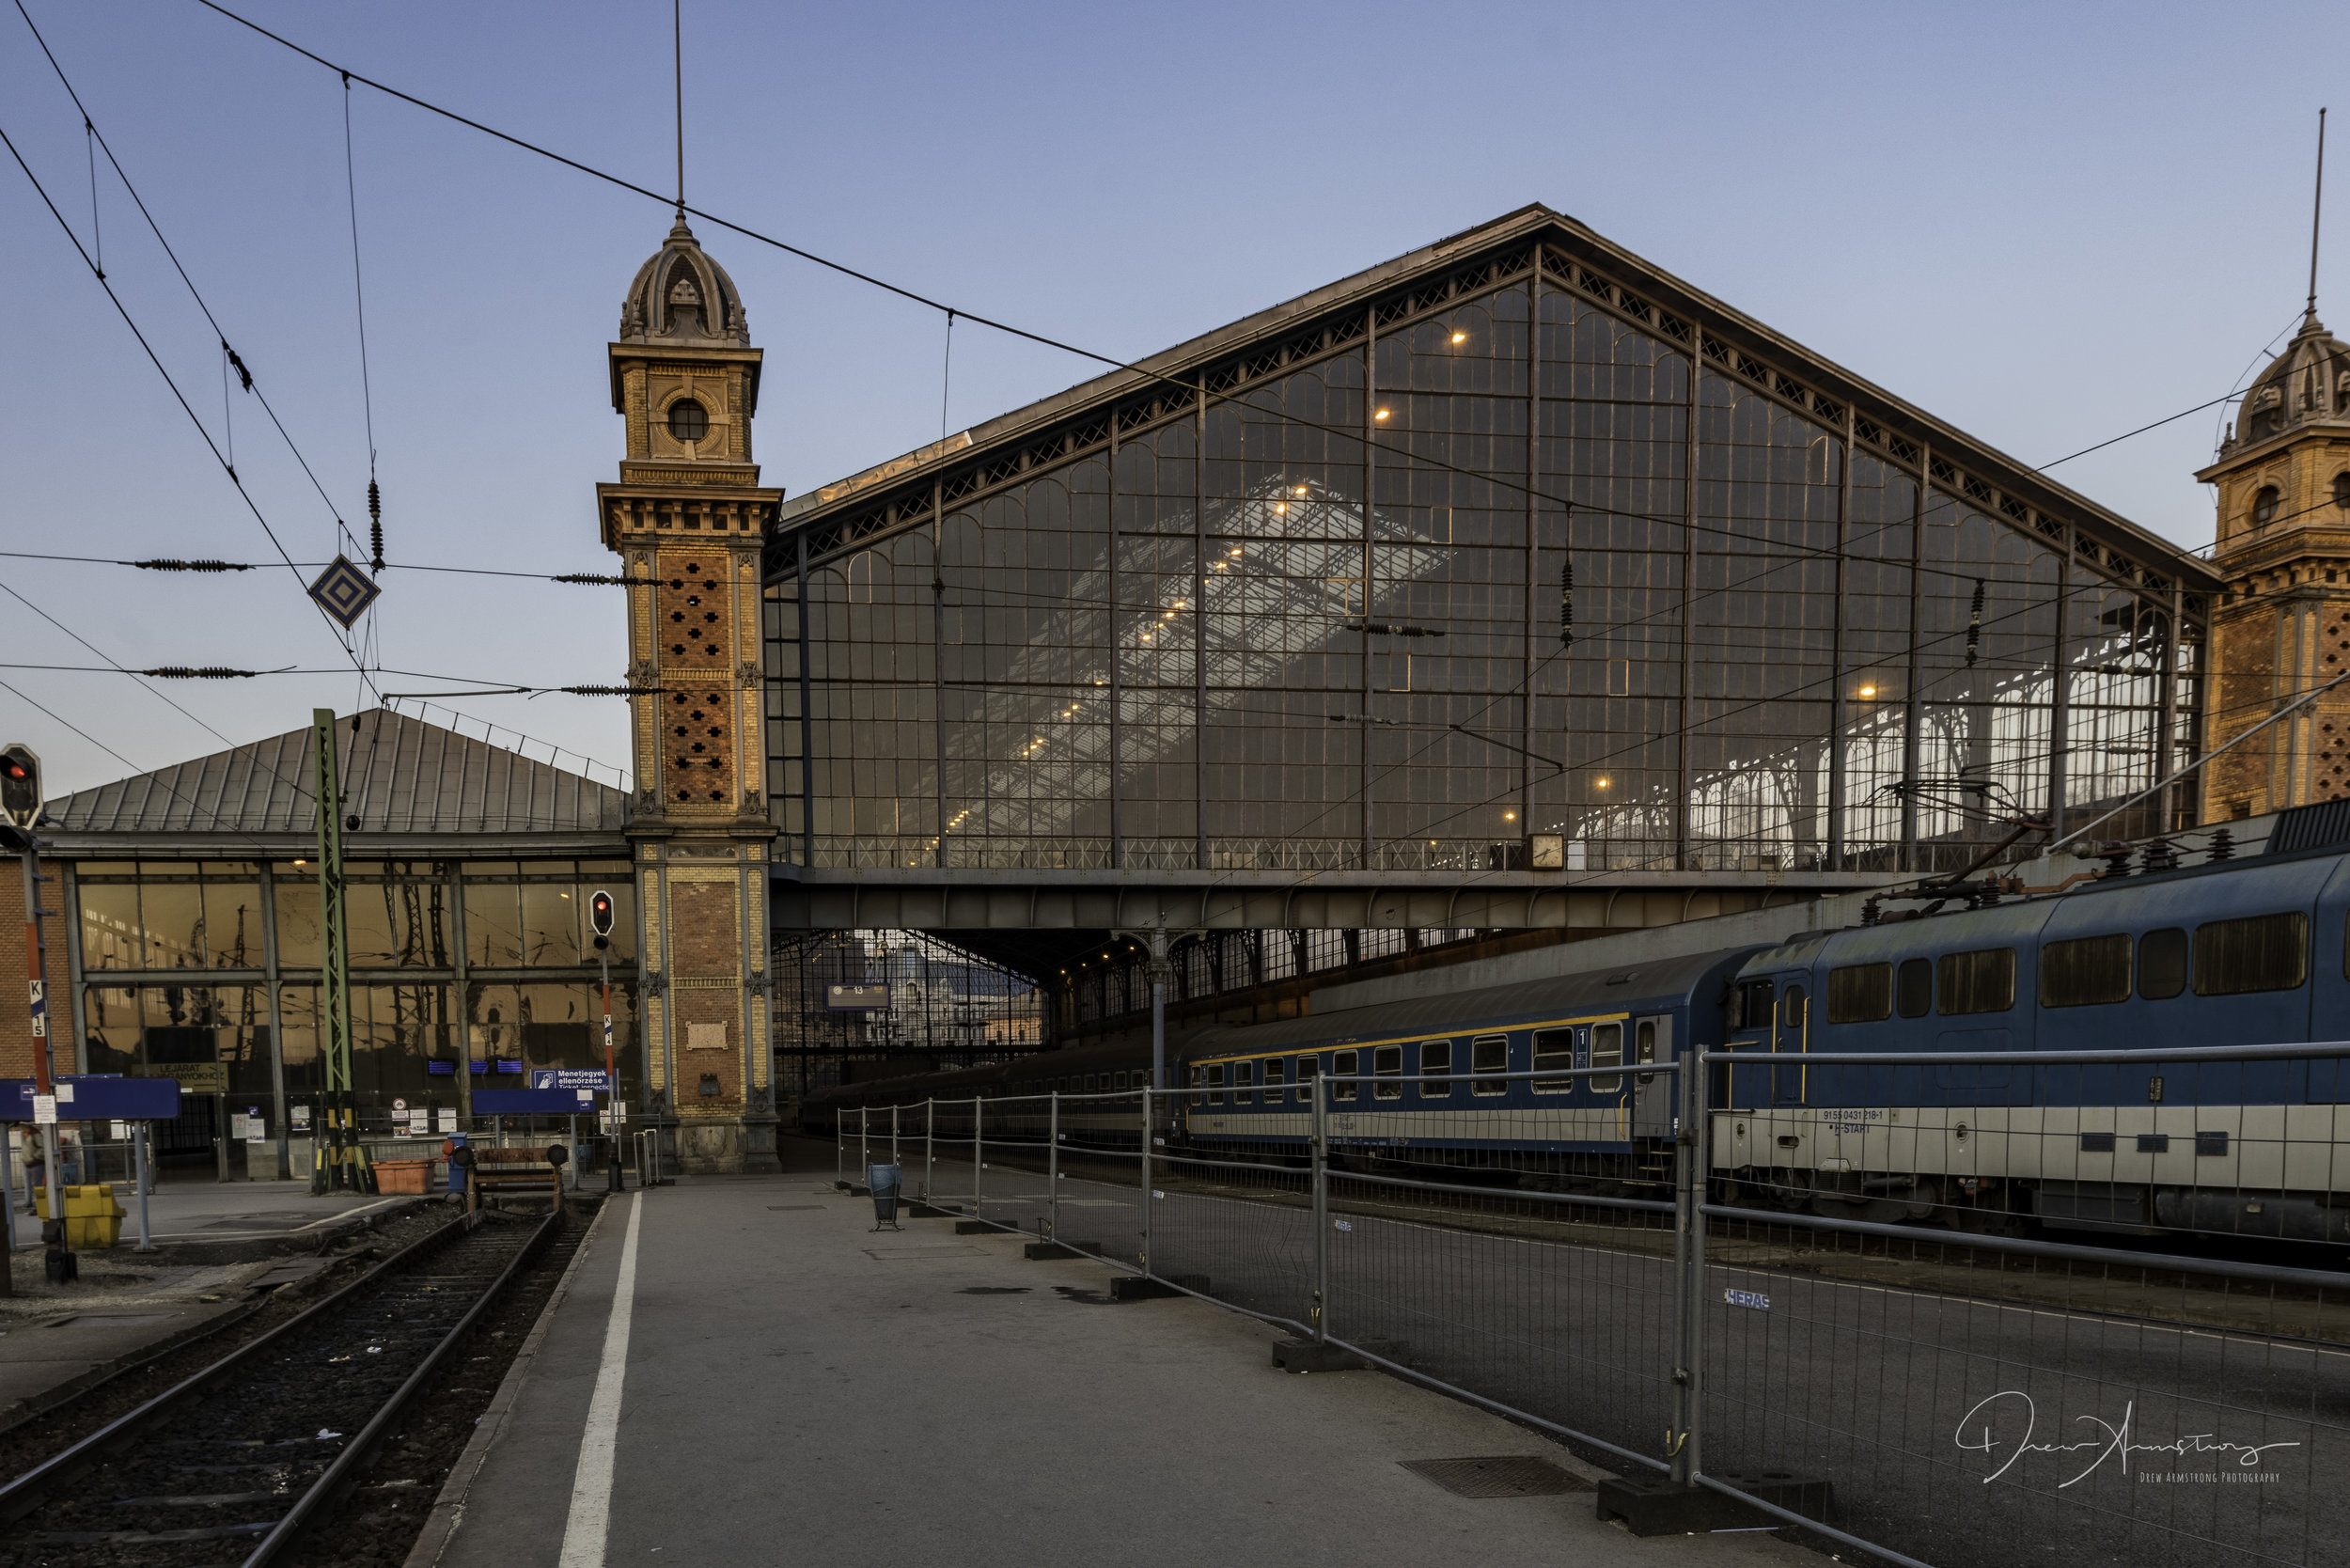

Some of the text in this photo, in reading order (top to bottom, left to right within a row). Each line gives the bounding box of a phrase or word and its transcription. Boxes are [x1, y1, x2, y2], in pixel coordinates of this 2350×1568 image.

[31, 981, 40, 996] K
[854, 985, 864, 995] 13
[604, 1015, 610, 1024] K
[1579, 1030, 1585, 1045] 1
[557, 1070, 607, 1079] Menetjegyek
[1843, 1110, 1862, 1121] 0431
[1863, 1110, 1883, 1120] 218-1
[1728, 1289, 1770, 1310] HERAS
